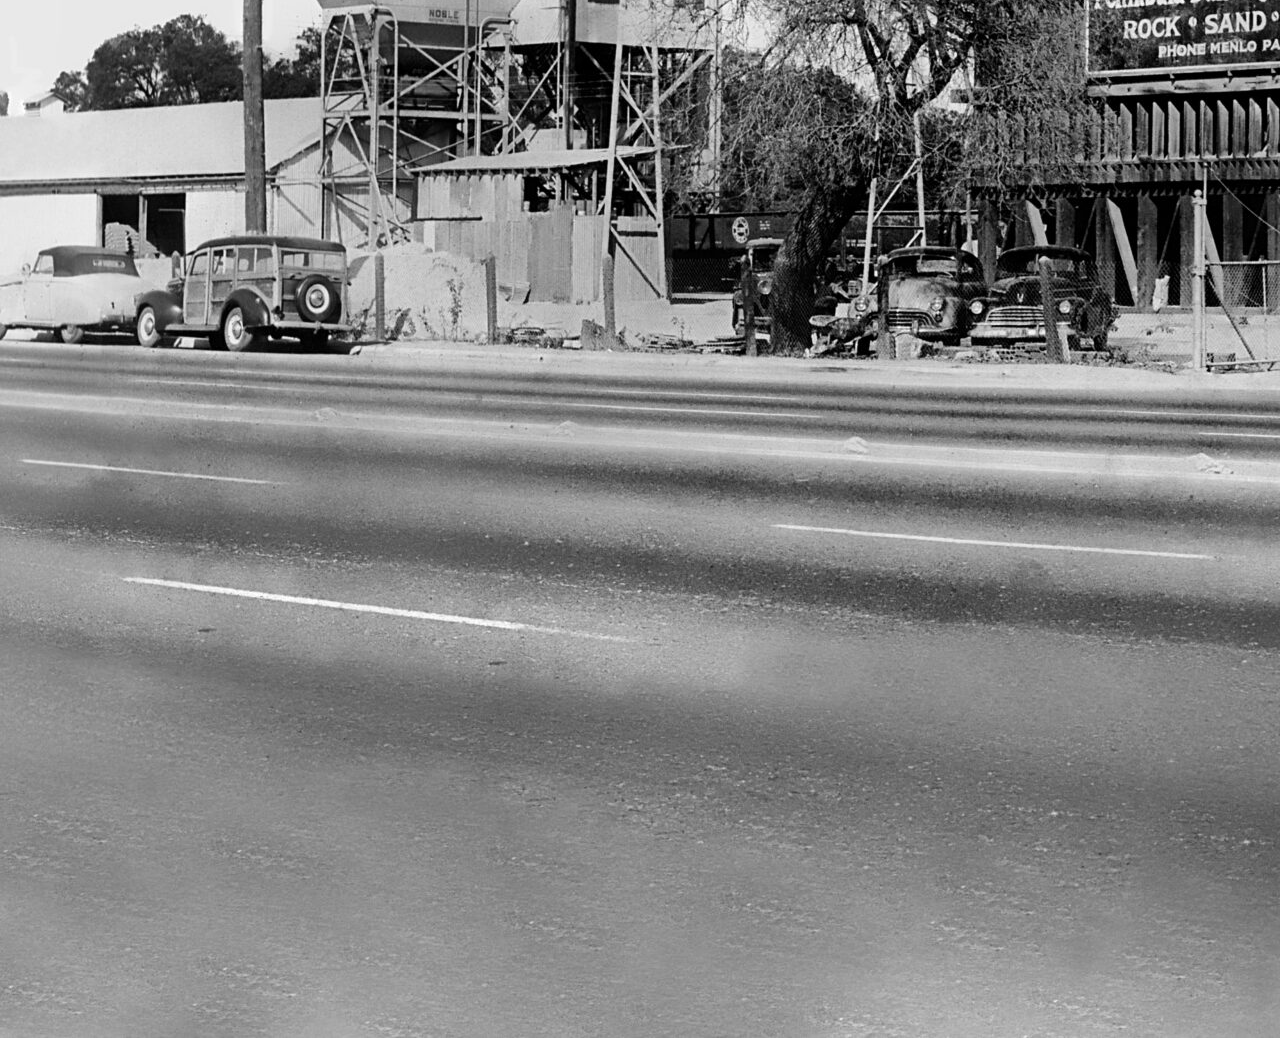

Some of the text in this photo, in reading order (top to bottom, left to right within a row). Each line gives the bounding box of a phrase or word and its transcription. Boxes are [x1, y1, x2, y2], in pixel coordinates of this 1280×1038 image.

[429, 9, 459, 19] NOBLE
[1123, 16, 1181, 39] ROCK
[1204, 10, 1267, 35] SAND
[1158, 43, 1206, 58] PHONE
[1210, 40, 1257, 55] MENLO
